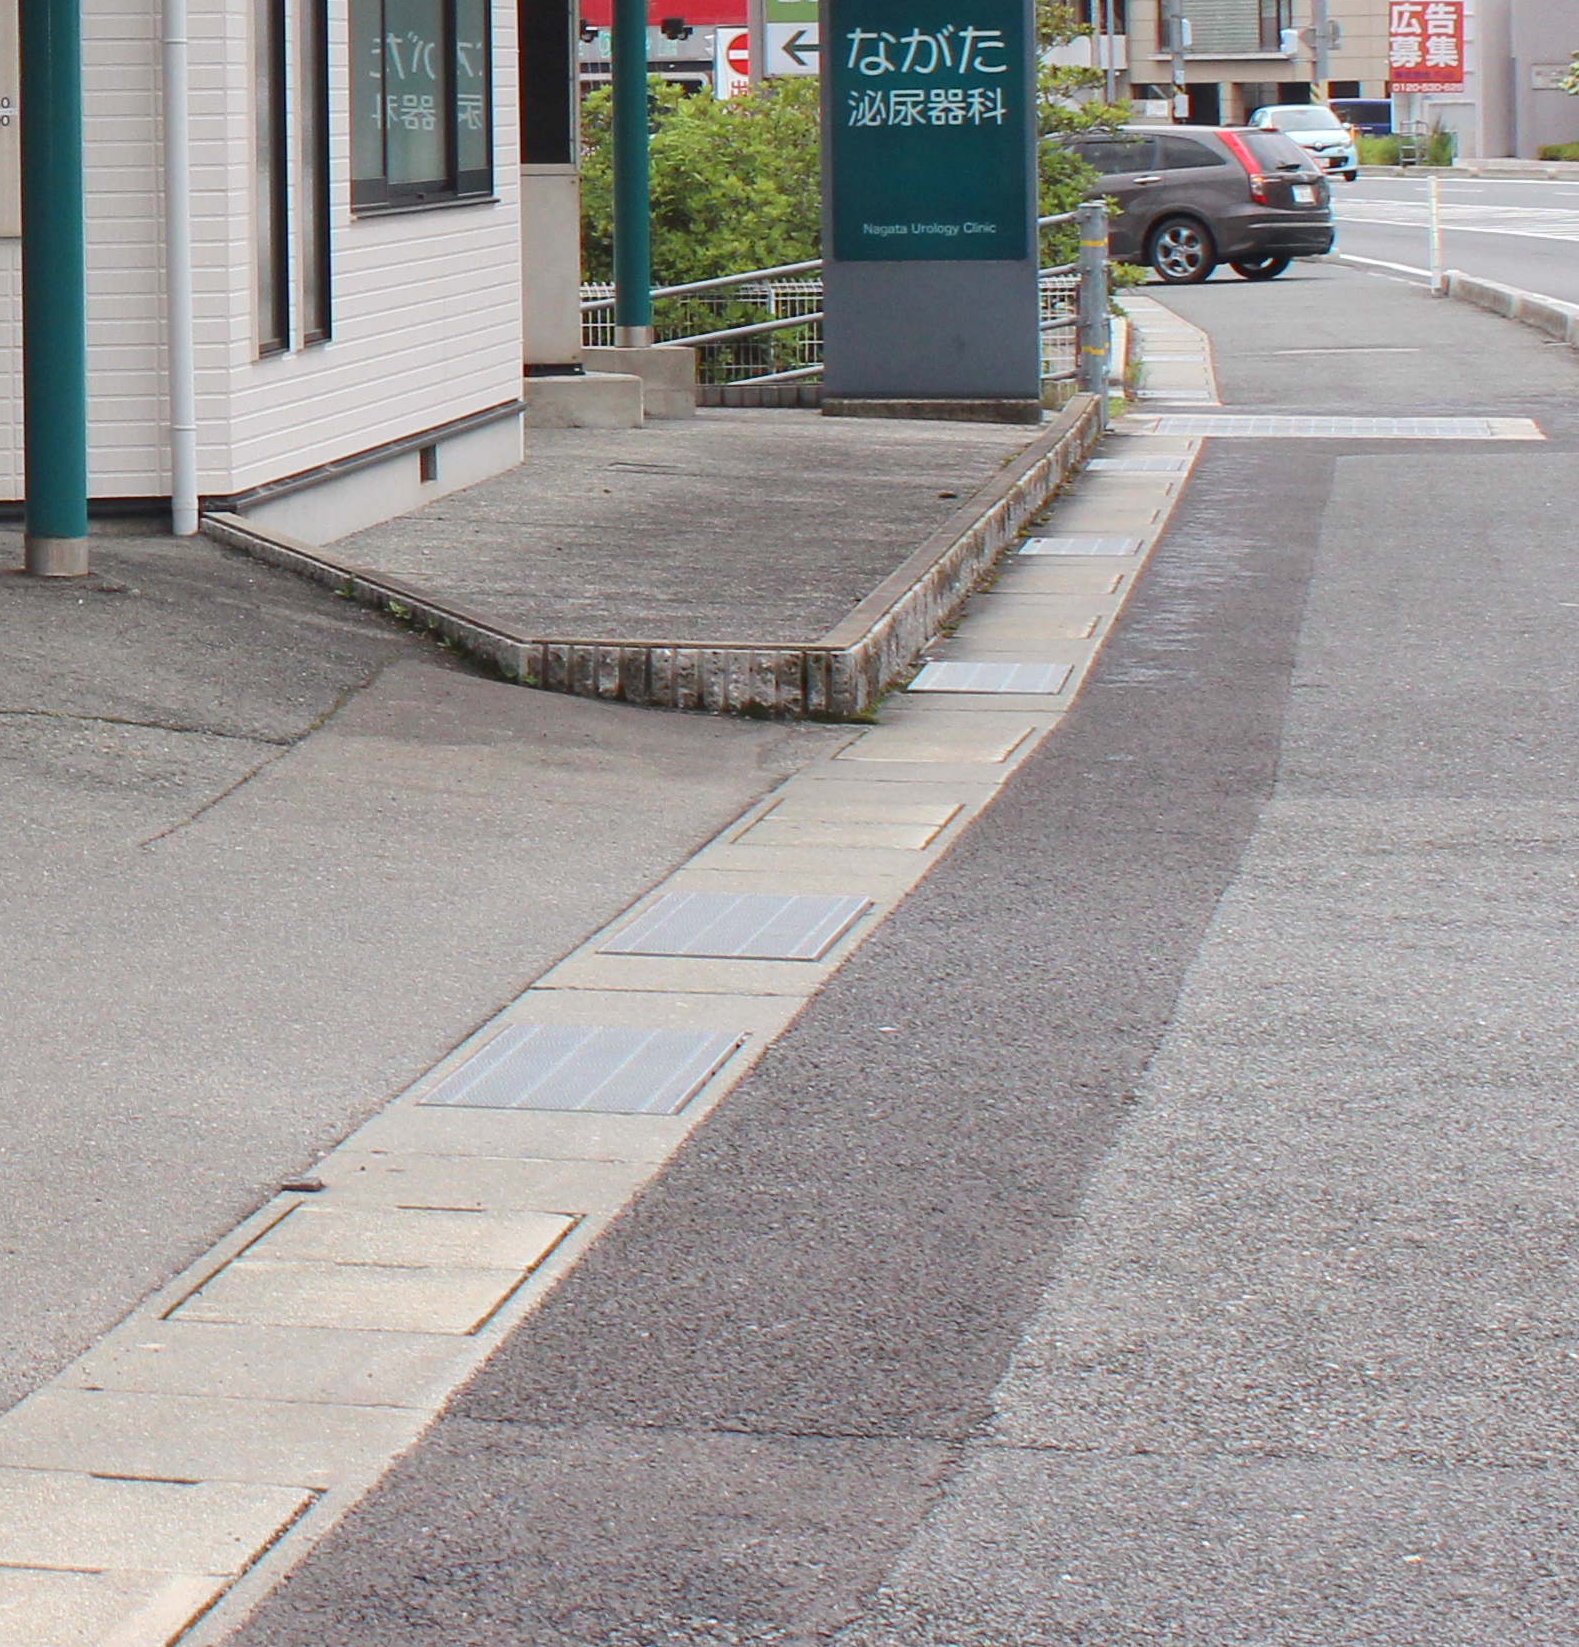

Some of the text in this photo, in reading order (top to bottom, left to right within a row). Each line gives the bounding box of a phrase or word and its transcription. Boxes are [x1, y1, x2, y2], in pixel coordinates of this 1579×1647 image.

[1390, 3, 1458, 34] 広告
[846, 24, 1008, 76] ながた
[1389, 36, 1459, 67] 募集
[847, 87, 1007, 127] 泌尿器科
[863, 221, 997, 237] Nagata Urology Clinic
